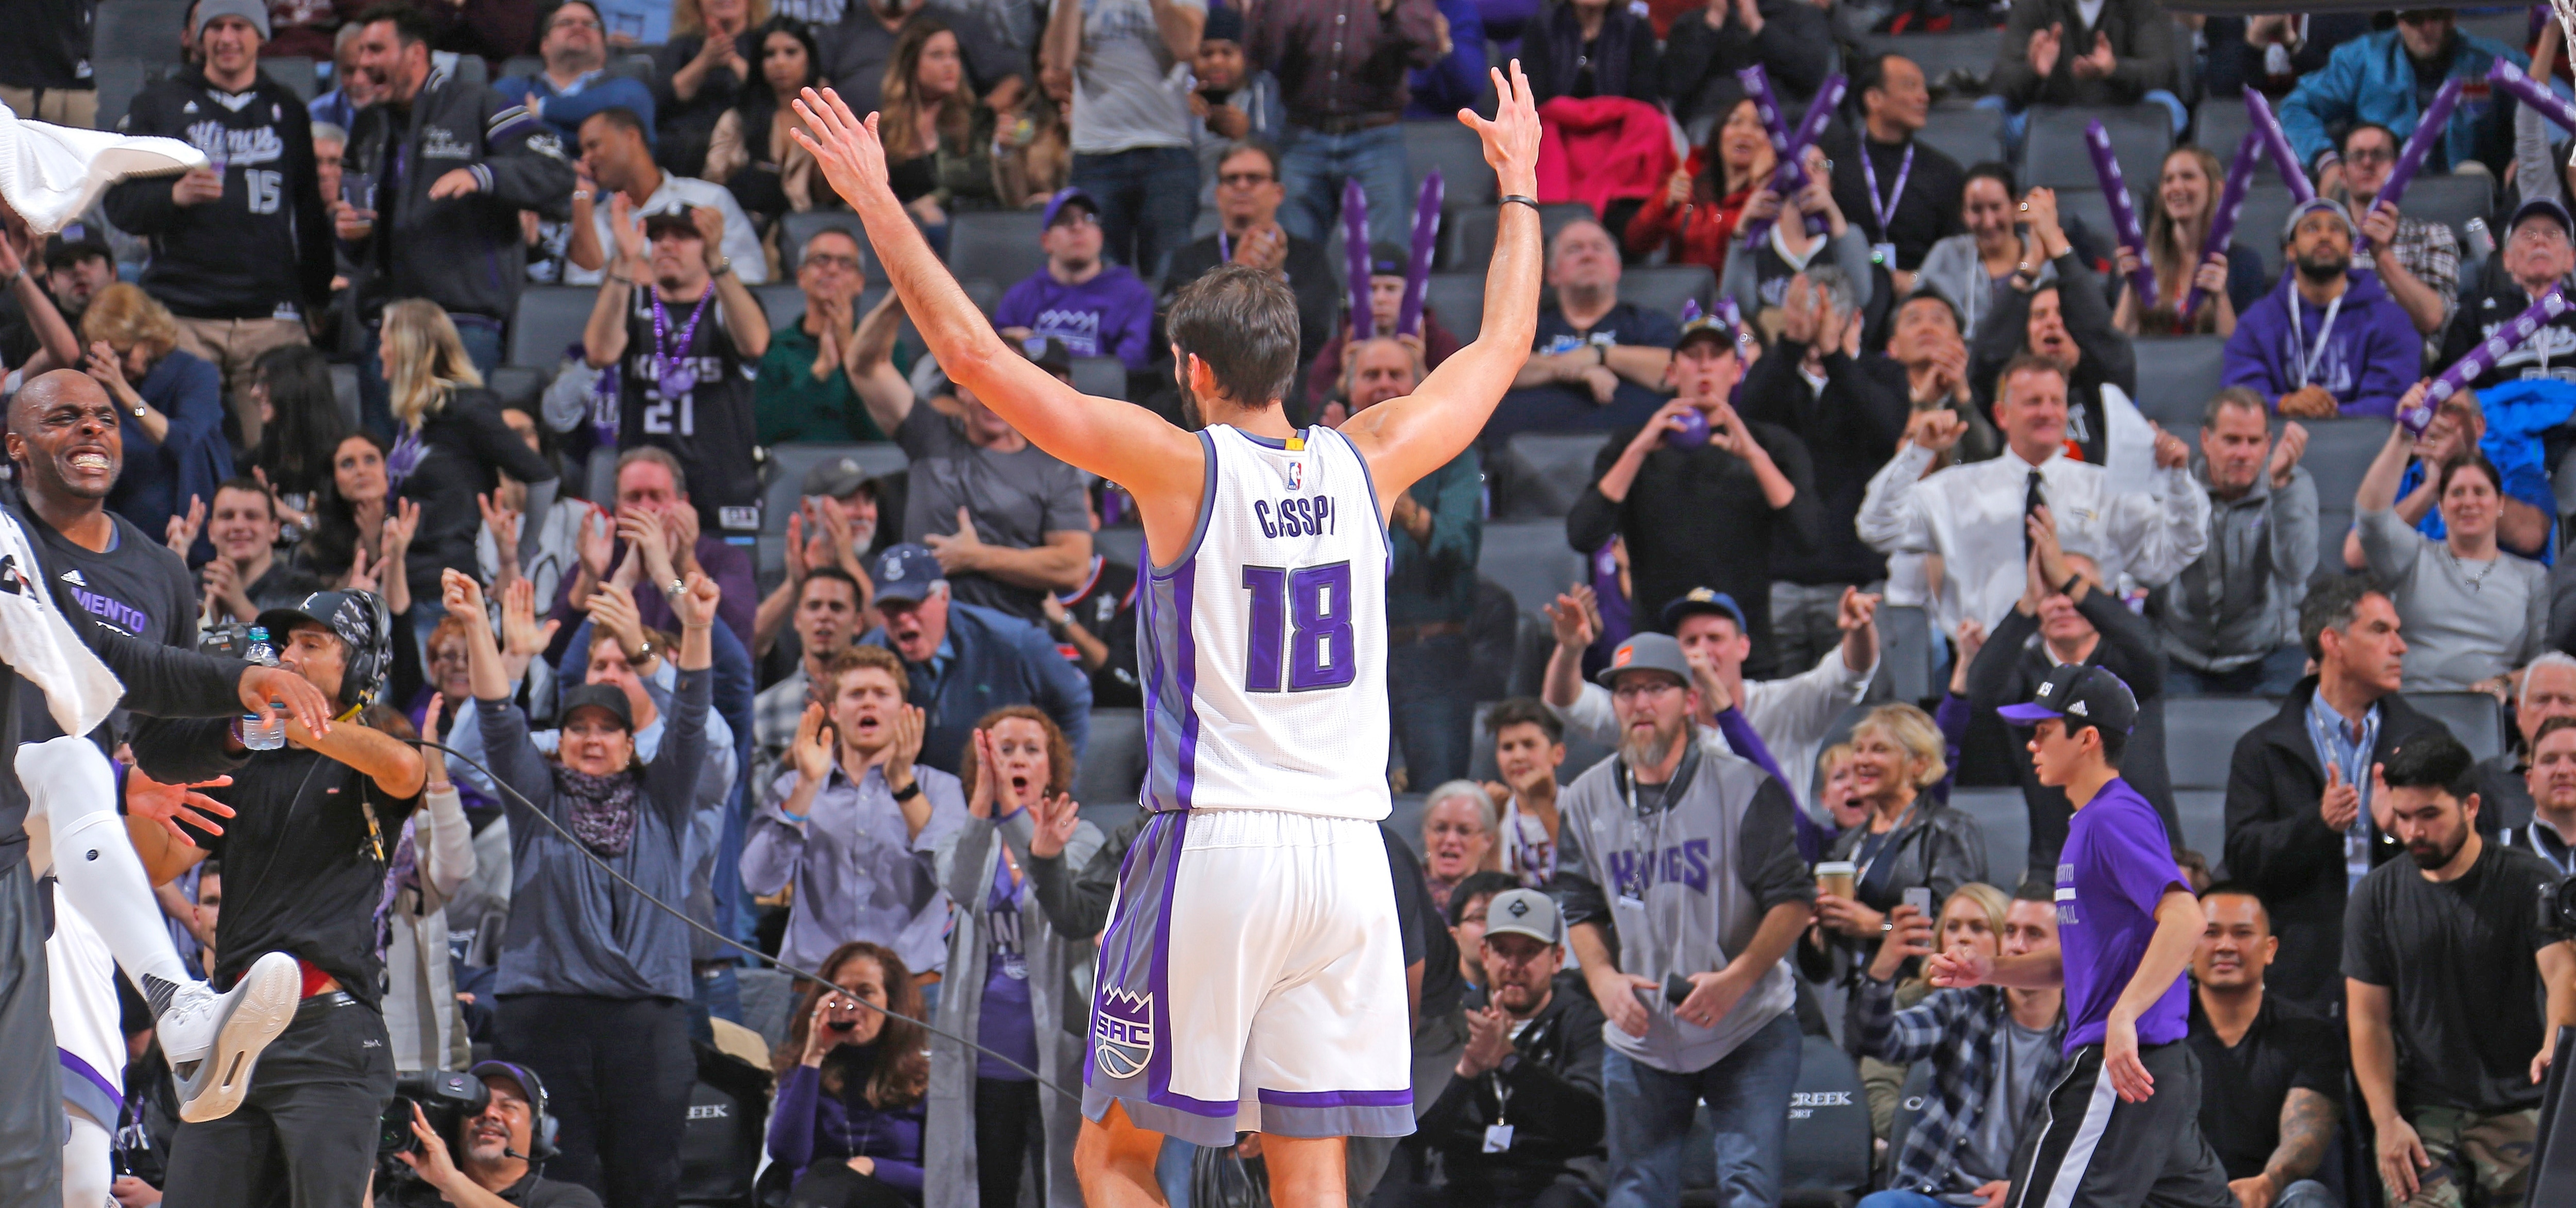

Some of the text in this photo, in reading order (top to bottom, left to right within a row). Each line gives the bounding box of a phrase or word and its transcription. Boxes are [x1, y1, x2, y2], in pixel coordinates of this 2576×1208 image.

[245, 168, 282, 214] 15
[630, 354, 722, 382] KIGS
[644, 390, 693, 436] 21
[1255, 495, 1335, 538] CASSPI
[1242, 560, 1356, 693] 18
[1097, 1014, 1150, 1045] SAC
[686, 1104, 728, 1119] EEK
